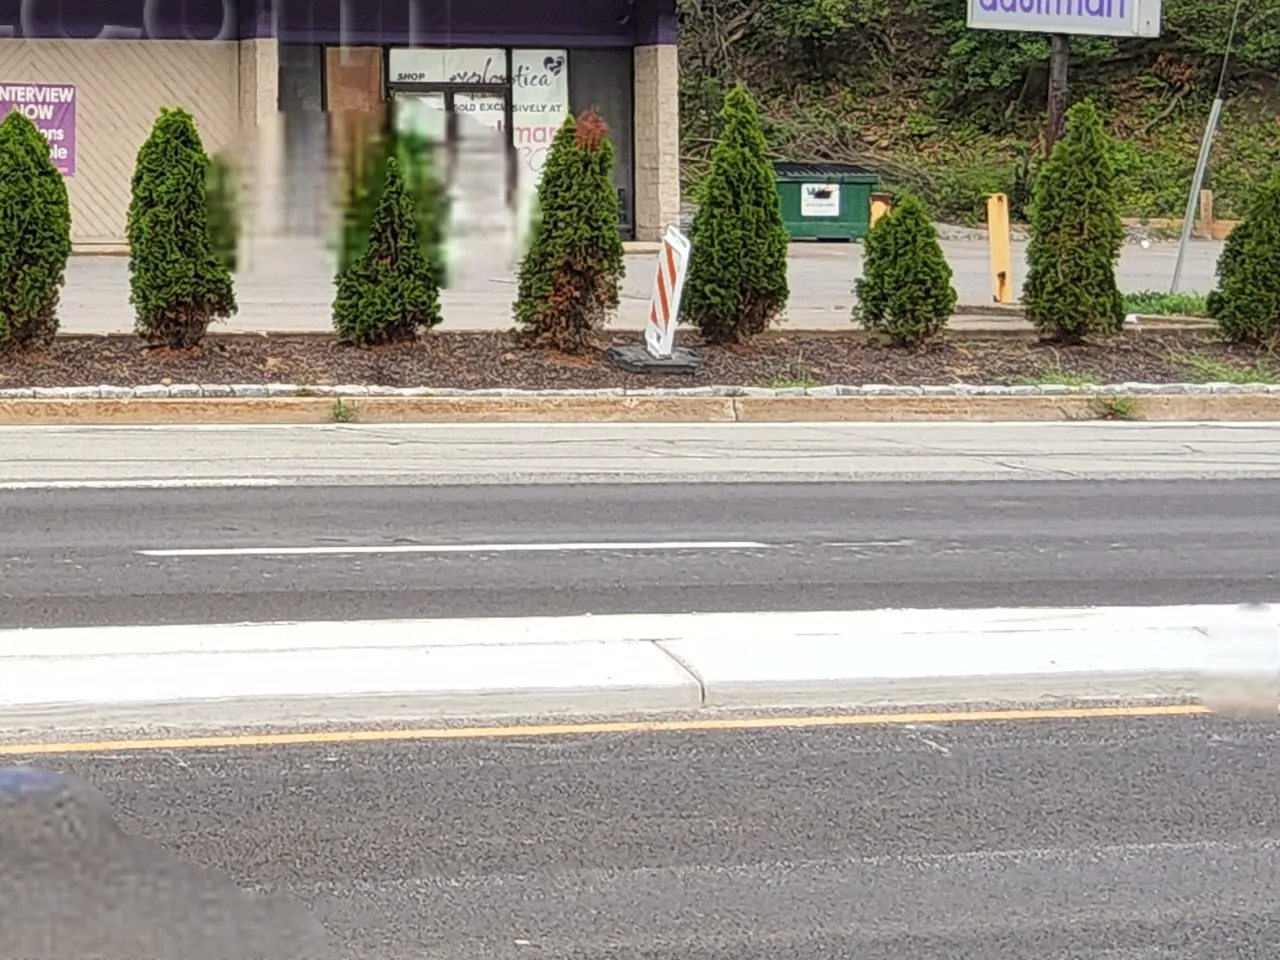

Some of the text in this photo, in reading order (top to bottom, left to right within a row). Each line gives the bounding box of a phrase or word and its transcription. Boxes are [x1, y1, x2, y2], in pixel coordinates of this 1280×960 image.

[397, 73, 425, 81] SHOP
[480, 103, 546, 113] EXCLSIVELY
[549, 104, 562, 113] AT
